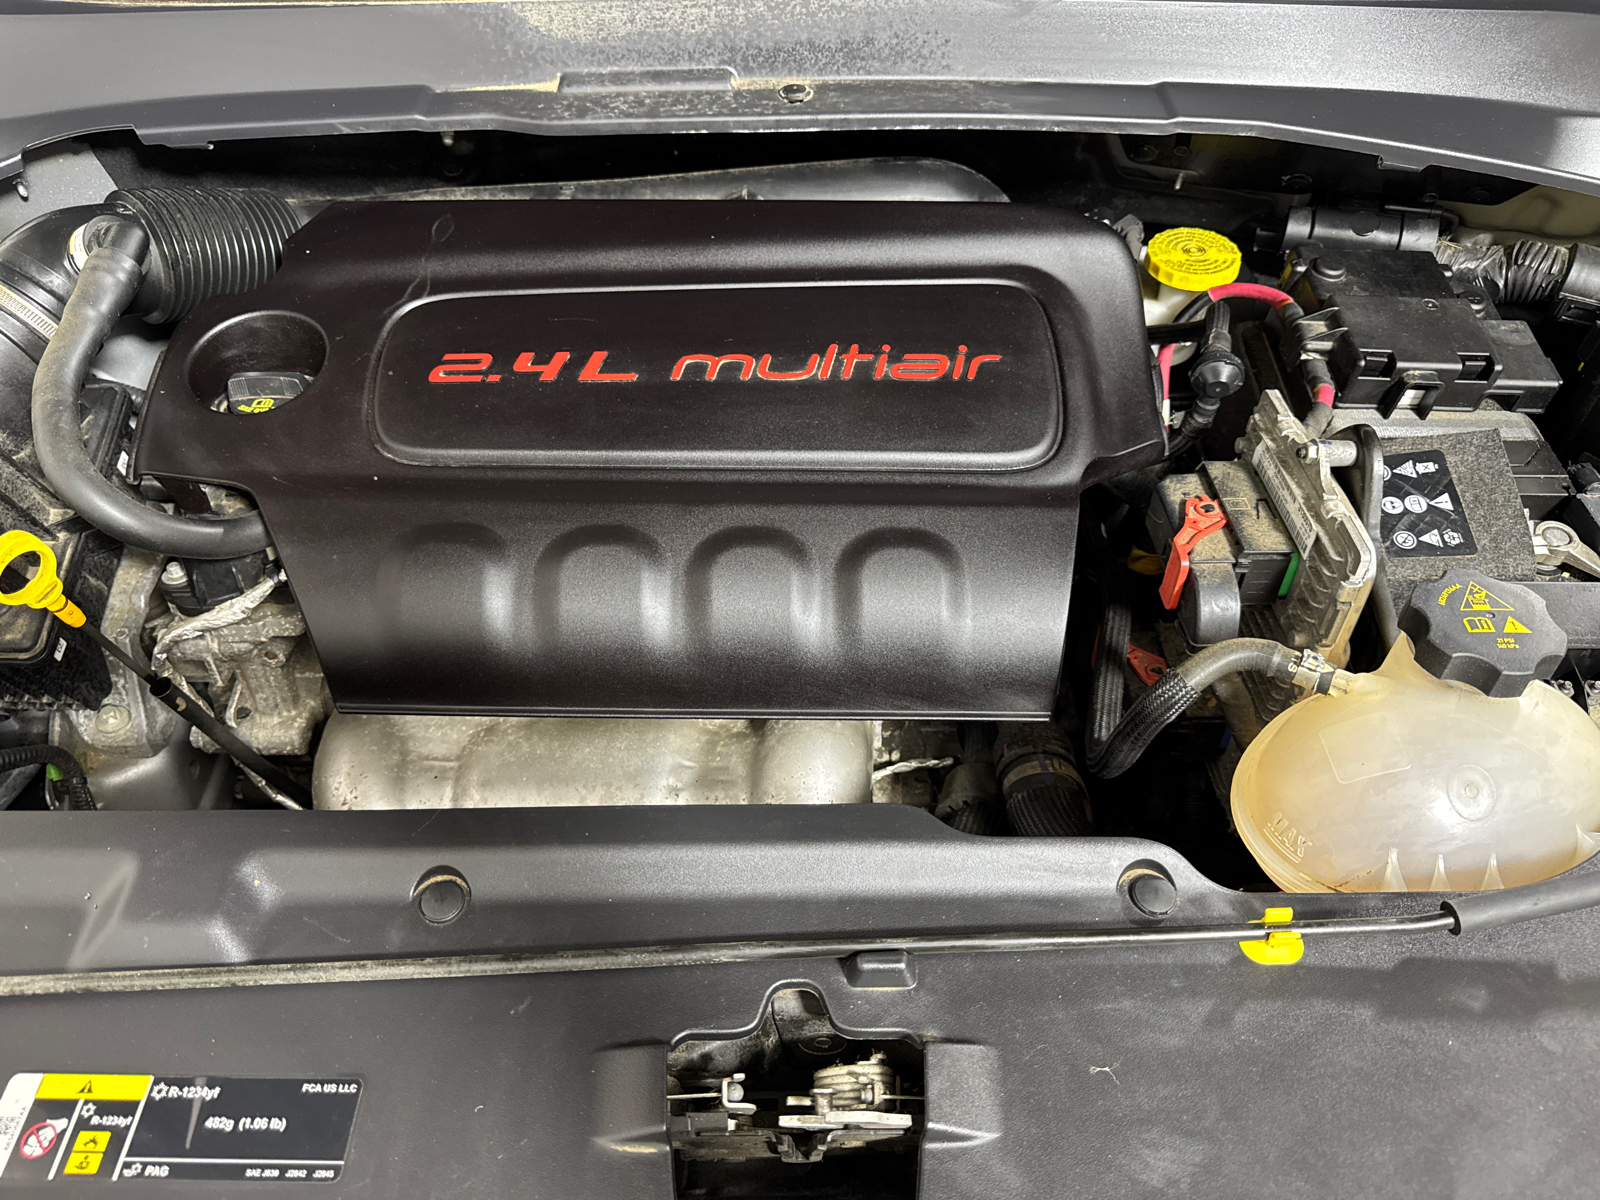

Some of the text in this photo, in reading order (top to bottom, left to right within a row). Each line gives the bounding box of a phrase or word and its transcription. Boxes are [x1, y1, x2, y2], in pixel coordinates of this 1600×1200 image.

[669, 343, 1003, 382] multiair
[1267, 811, 1313, 857] MAX
[168, 1086, 221, 1101] R-1234yf
[302, 1083, 358, 1094] FCA US LLC
[90, 1115, 133, 1128] R-1234yf
[204, 1117, 235, 1132] 482g
[239, 1117, 269, 1132] (1.06
[144, 1164, 170, 1178] PAG
